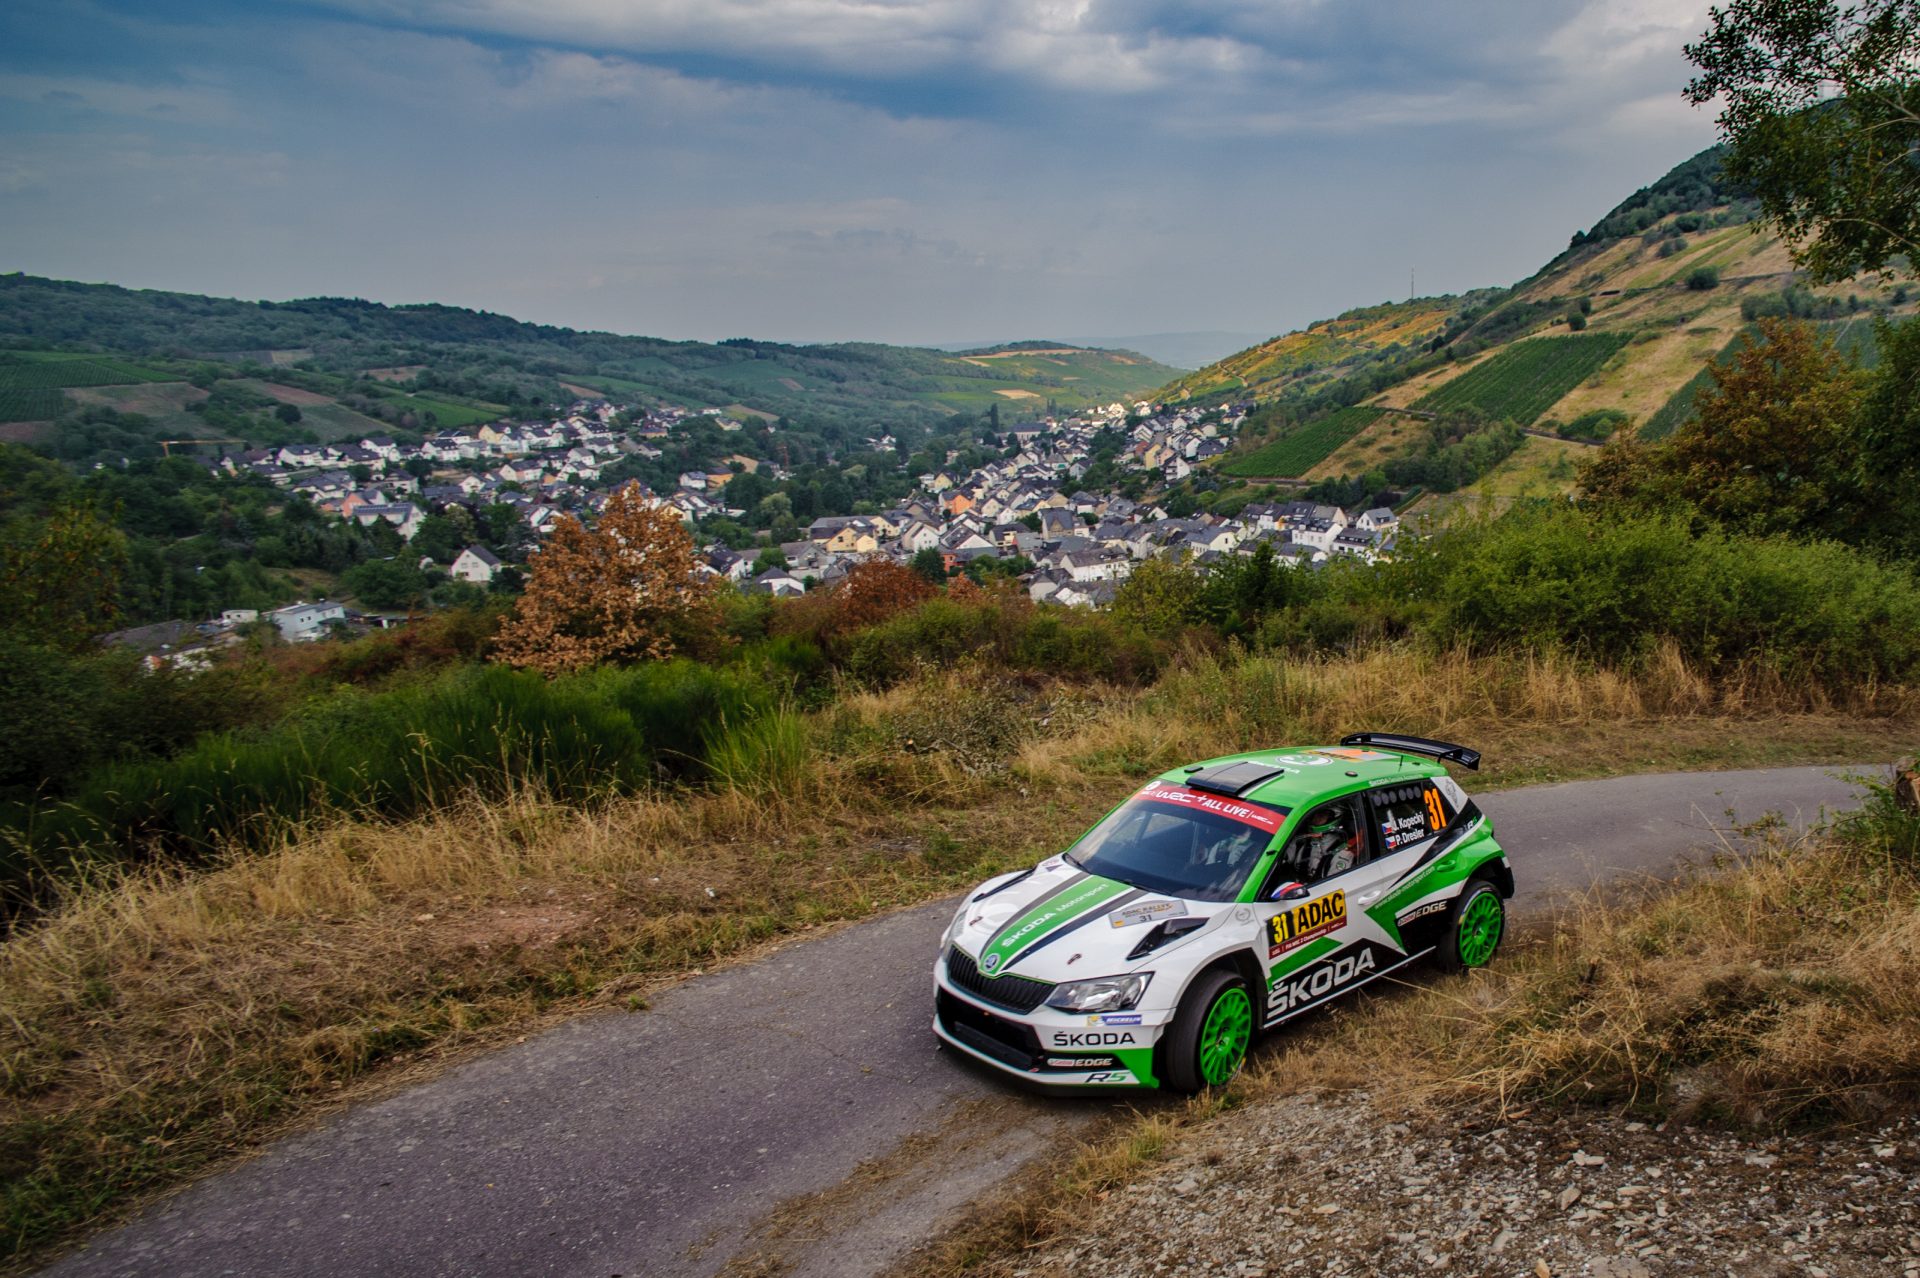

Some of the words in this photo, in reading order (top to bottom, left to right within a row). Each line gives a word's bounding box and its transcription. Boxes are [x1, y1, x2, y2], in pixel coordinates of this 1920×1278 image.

[1204, 799, 1222, 811] ALL
[1223, 804, 1250, 818] LIVE
[1423, 787, 1448, 831] 31
[1398, 811, 1425, 829] Kopecký
[1395, 834, 1403, 846] P.
[1402, 828, 1425, 843] Dresler
[1056, 883, 1110, 912] Motorsport
[1139, 914, 1153, 922] 31
[1272, 913, 1290, 944] 31
[1298, 892, 1344, 933] ADAC
[1416, 901, 1448, 918] EDGE
[1266, 946, 1376, 1020] ŠKODA
[1053, 1030, 1136, 1047] ŠKODA
[1075, 1057, 1114, 1067] EDGE
[1084, 1071, 1131, 1083] R5
